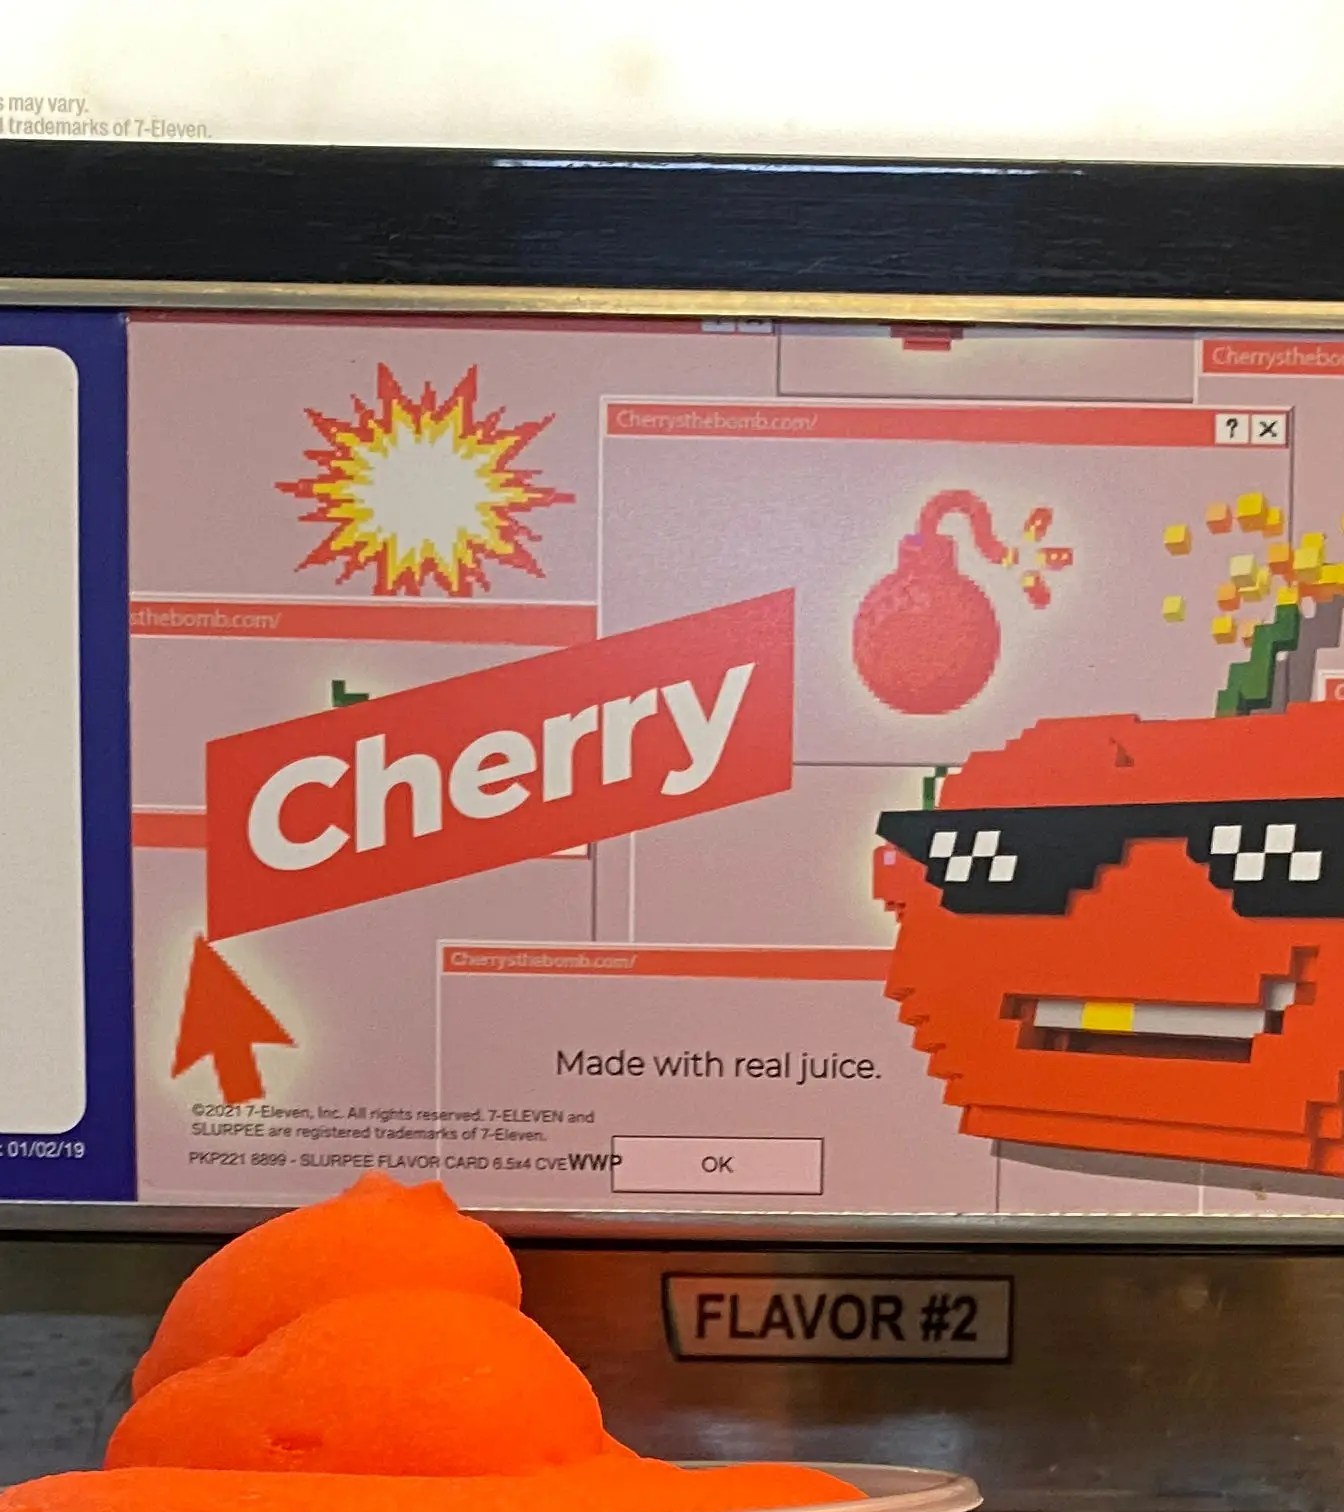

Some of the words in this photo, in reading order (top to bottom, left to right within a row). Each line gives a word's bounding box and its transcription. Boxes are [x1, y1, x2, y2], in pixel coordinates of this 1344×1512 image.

[9, 95, 44, 113] may
[48, 96, 89, 114] vary.
[9, 117, 109, 137] trademarks
[113, 119, 132, 137] of
[135, 119, 212, 139] 7-Eleven.
[247, 662, 757, 871] Cherry
[556, 1049, 646, 1078] Made
[653, 1051, 725, 1079] with
[735, 1053, 791, 1080] real
[796, 1054, 883, 1086] juice.
[347, 1106, 367, 1119] All
[369, 1107, 413, 1123] rights
[488, 1109, 564, 1123] 7-ELEVEN
[567, 1110, 595, 1124] and
[191, 1123, 265, 1137] SLURPEE
[268, 1126, 292, 1137] are
[295, 1124, 371, 1140] registered
[374, 1126, 458, 1140] trademarks
[462, 1128, 478, 1140] of
[7, 1140, 86, 1159] 01/02/19
[300, 1154, 377, 1168] SLURPEE
[378, 1155, 441, 1169] FLAVOR
[444, 1155, 489, 1170] CARD
[701, 1156, 734, 1175] OK
[694, 1293, 906, 1342] FLAVOR
[920, 1294, 978, 1342] #2
